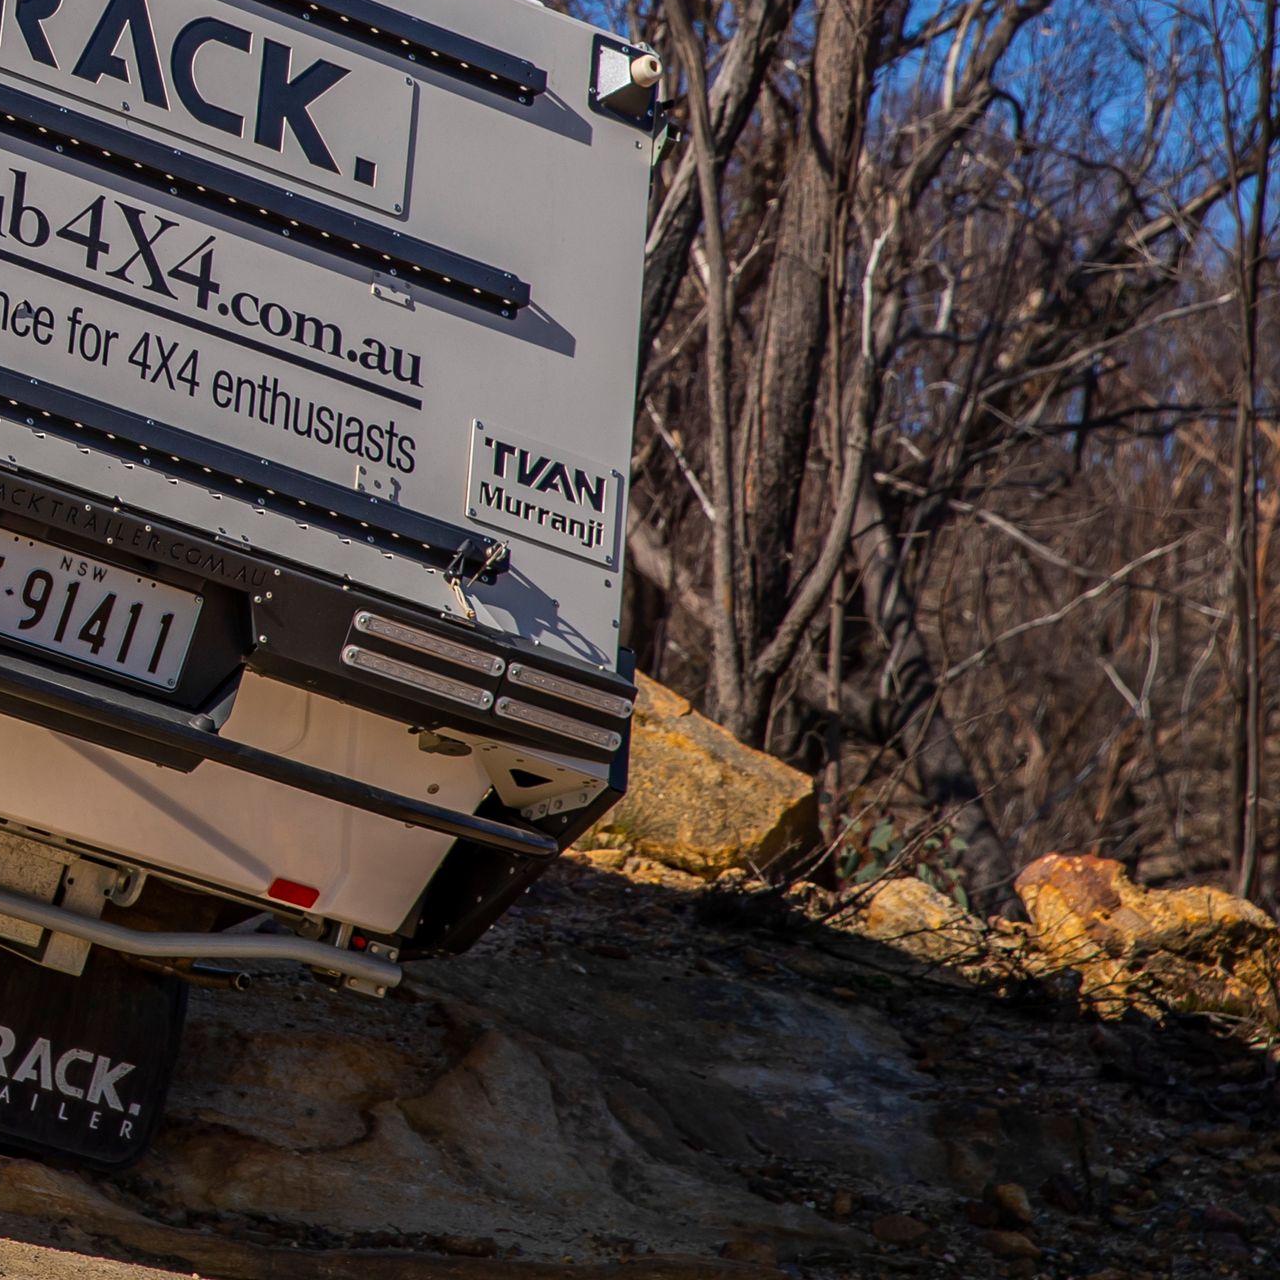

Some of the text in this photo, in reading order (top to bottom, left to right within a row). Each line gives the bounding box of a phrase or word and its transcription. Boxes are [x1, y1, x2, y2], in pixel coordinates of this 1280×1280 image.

[64, 313, 120, 368] for
[127, 332, 200, 396] 4X4
[210, 369, 417, 476] enthusiasts
[485, 440, 606, 512] TVAN
[478, 480, 606, 549] Murranji
[59, 555, 109, 582] NSW
